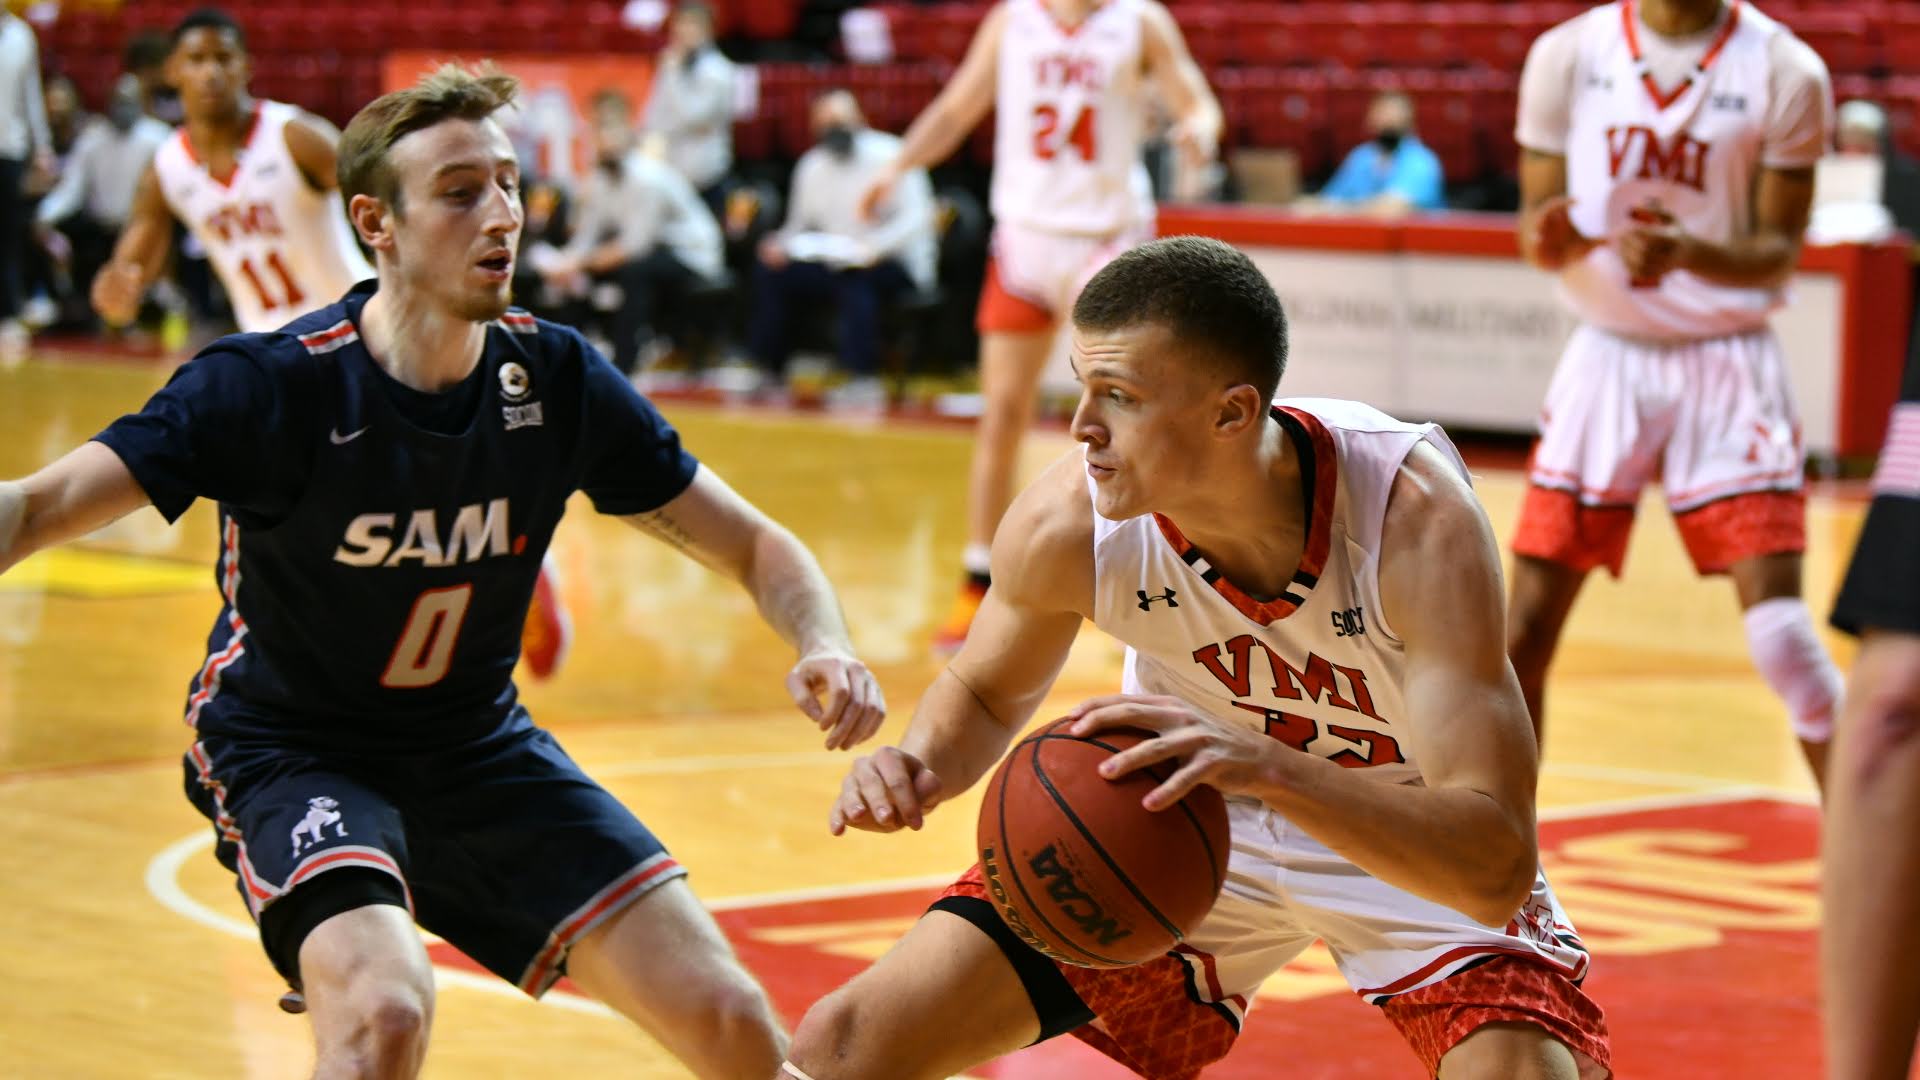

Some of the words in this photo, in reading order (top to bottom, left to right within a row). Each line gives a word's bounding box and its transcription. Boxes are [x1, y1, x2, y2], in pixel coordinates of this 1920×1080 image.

[1031, 103, 1098, 163] 24
[1605, 124, 1711, 194] VMI
[240, 250, 305, 312] 11
[333, 497, 528, 568] SAM.
[379, 582, 474, 689] 0
[1192, 634, 1390, 725] VMI
[1030, 843, 1134, 945] NCAA
